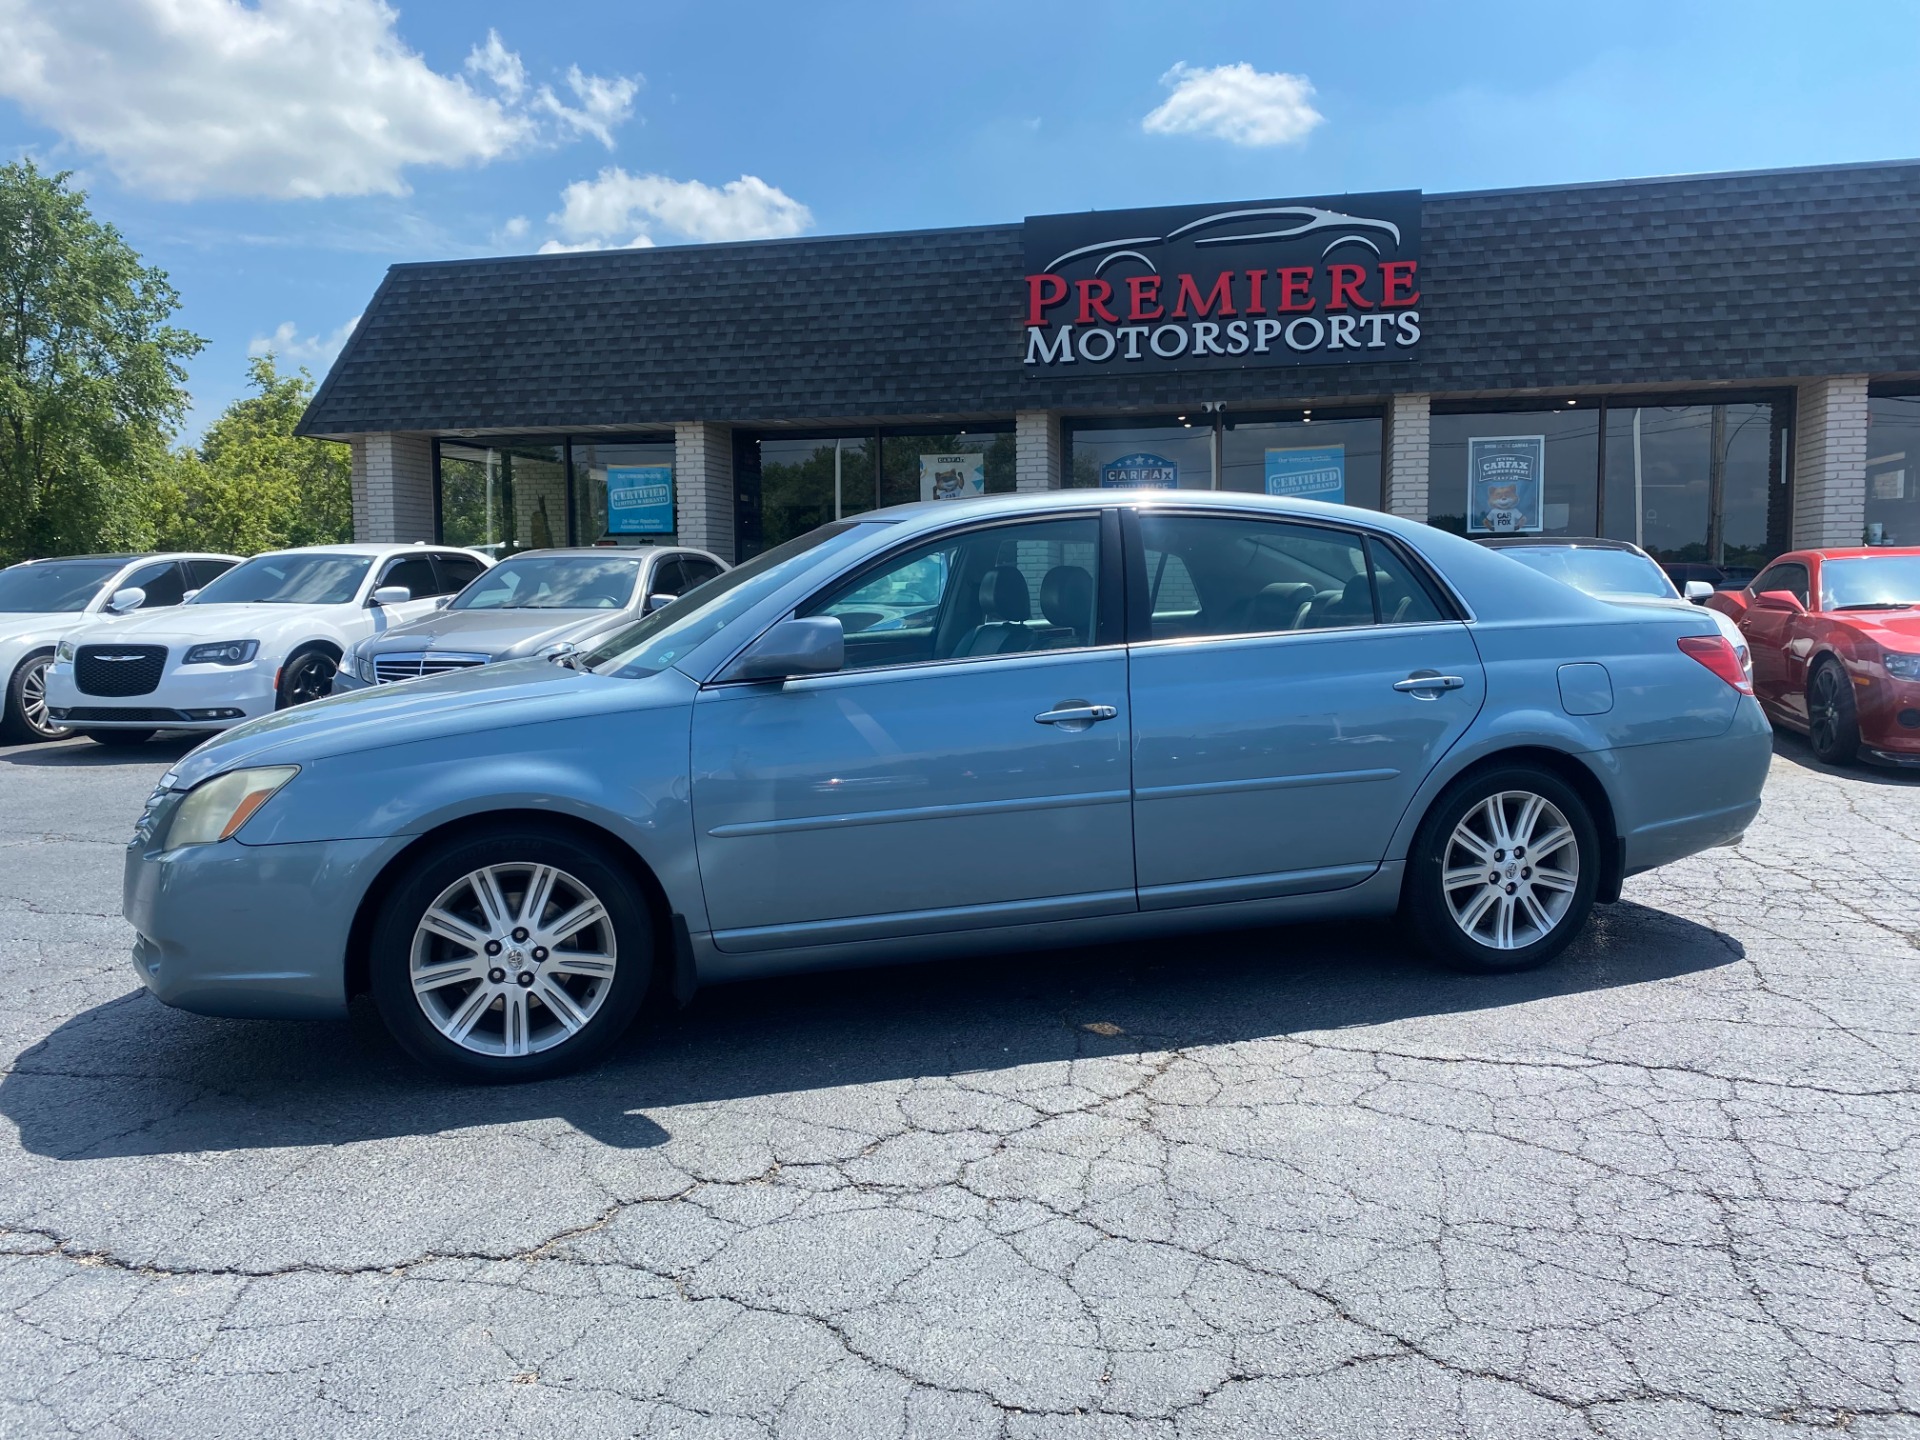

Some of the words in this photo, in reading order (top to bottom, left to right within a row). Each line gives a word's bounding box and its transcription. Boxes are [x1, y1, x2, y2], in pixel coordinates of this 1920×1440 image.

[1024, 261, 1420, 327] PREMIERE
[1024, 312, 1421, 363] MOTORSPORTS
[1483, 461, 1529, 471] CARFAX
[1107, 469, 1172, 480] CARFAX
[1273, 471, 1338, 488] CERTIFIED
[614, 488, 666, 500] CERTIFIED
[1274, 486, 1301, 494] LIMITED
[1302, 481, 1338, 490] WARRANTY
